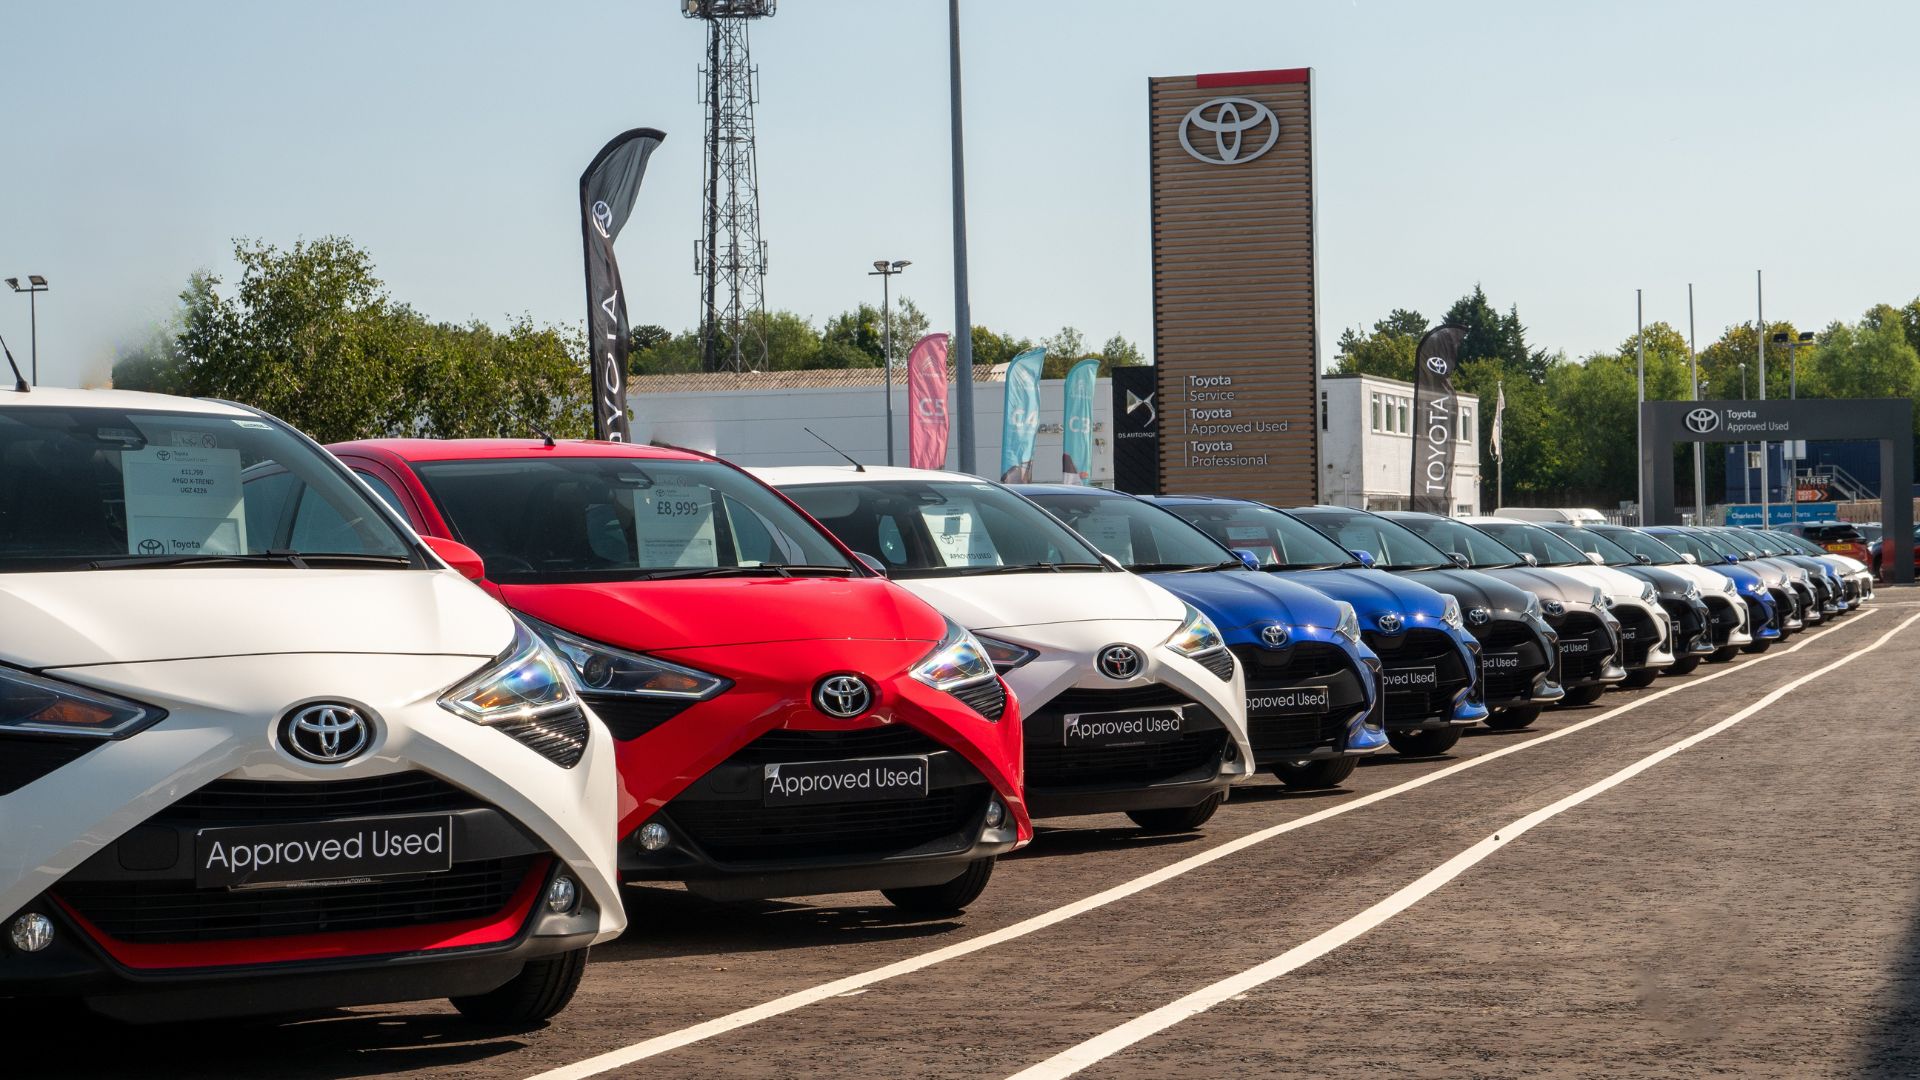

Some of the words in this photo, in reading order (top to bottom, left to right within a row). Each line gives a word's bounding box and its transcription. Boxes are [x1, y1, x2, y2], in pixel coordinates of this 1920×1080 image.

[1190, 376, 1232, 388] Toyota
[1190, 390, 1235, 402] Service
[919, 398, 945, 417] C5
[1190, 408, 1232, 421] Toyota
[1727, 409, 1757, 420] Toyota
[1069, 416, 1090, 433] C3
[1190, 421, 1251, 436] Approved
[1256, 420, 1288, 432] Used
[1727, 421, 1766, 432] Approved
[1768, 421, 1789, 431] Used
[1191, 440, 1233, 454] Toyota
[1426, 396, 1450, 493] TOYOTA
[1191, 453, 1268, 467] Professional
[1799, 477, 1828, 485] TYRES
[657, 501, 699, 517] £8,999
[171, 539, 200, 551] Toyota
[1622, 631, 1635, 640] sed
[1570, 643, 1588, 653] Used
[1495, 657, 1517, 668] Used
[1410, 671, 1435, 684] Used
[1246, 693, 1295, 711] pproved
[1297, 690, 1326, 706] Used
[1070, 716, 1143, 740] Approved
[1146, 716, 1180, 733] Used
[770, 768, 870, 797] Approved
[875, 766, 922, 788] Used
[206, 831, 363, 873] Approved
[372, 826, 443, 858] Used
